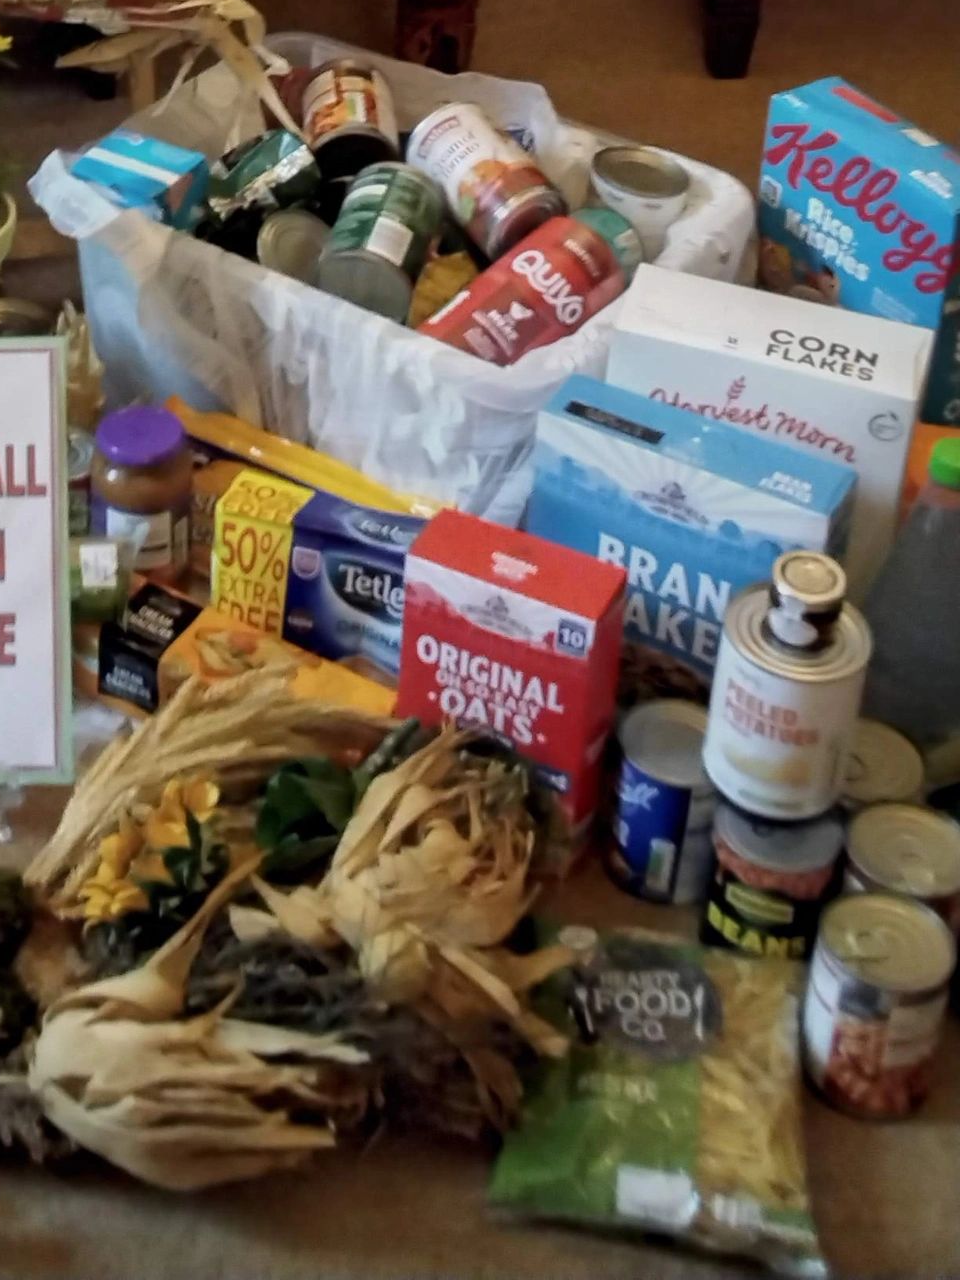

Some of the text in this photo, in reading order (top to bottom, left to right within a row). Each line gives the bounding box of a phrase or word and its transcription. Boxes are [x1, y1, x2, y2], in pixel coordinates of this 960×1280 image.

[765, 124, 960, 294] Kellogg
[765, 343, 874, 382] FLAKES
[769, 329, 879, 368] CORN
[775, 412, 856, 463] Morn
[220, 522, 285, 582] 50%
[598, 530, 732, 624] BRAN
[218, 571, 282, 608] EXTRA
[339, 563, 405, 613] Tetle
[560, 627, 584, 649] 10
[623, 591, 723, 666] AKE
[416, 634, 564, 714] ORIGINAL
[440, 687, 533, 745] OATS
[707, 900, 806, 956] BEANS
[593, 989, 691, 1018] FOOD
